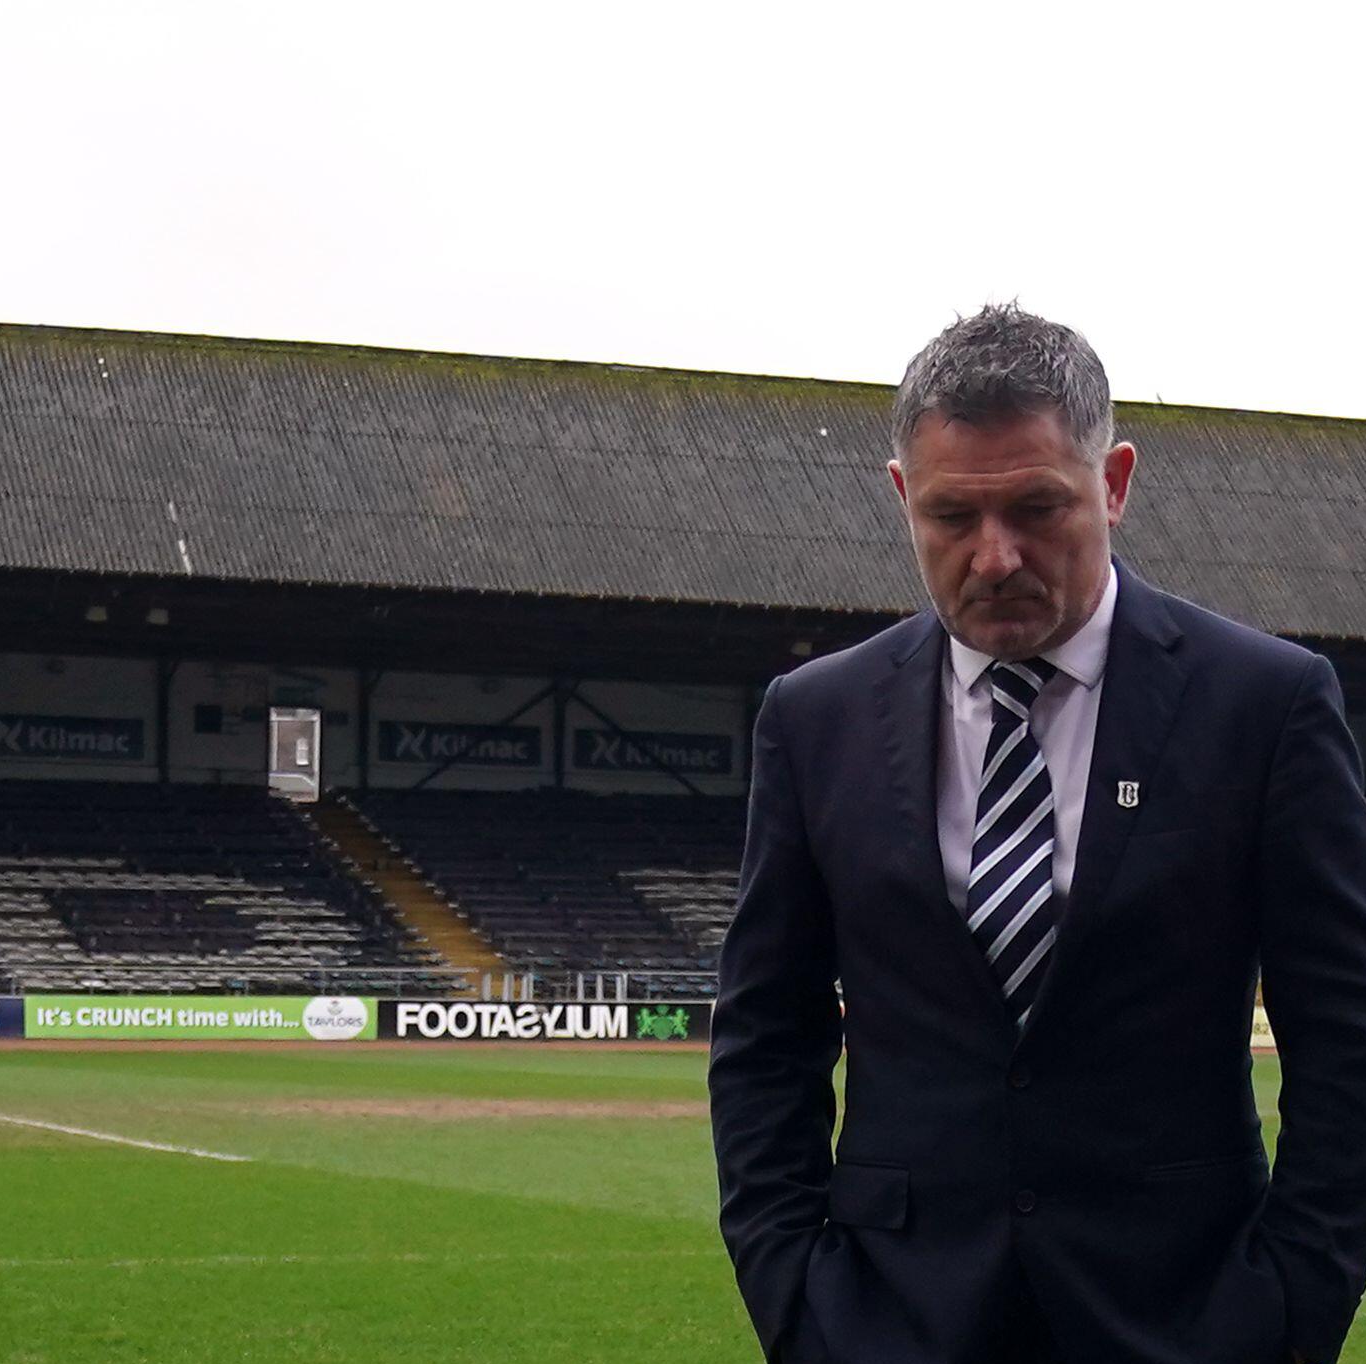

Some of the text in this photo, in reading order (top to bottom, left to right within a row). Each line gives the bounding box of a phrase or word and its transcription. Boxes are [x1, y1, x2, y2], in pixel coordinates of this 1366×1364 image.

[28, 725, 131, 753] Kilmac
[37, 1007, 72, 1027] It's
[77, 1007, 175, 1027] CRUNCH
[177, 1007, 229, 1027] time
[307, 1016, 364, 1028] TAYLORS
